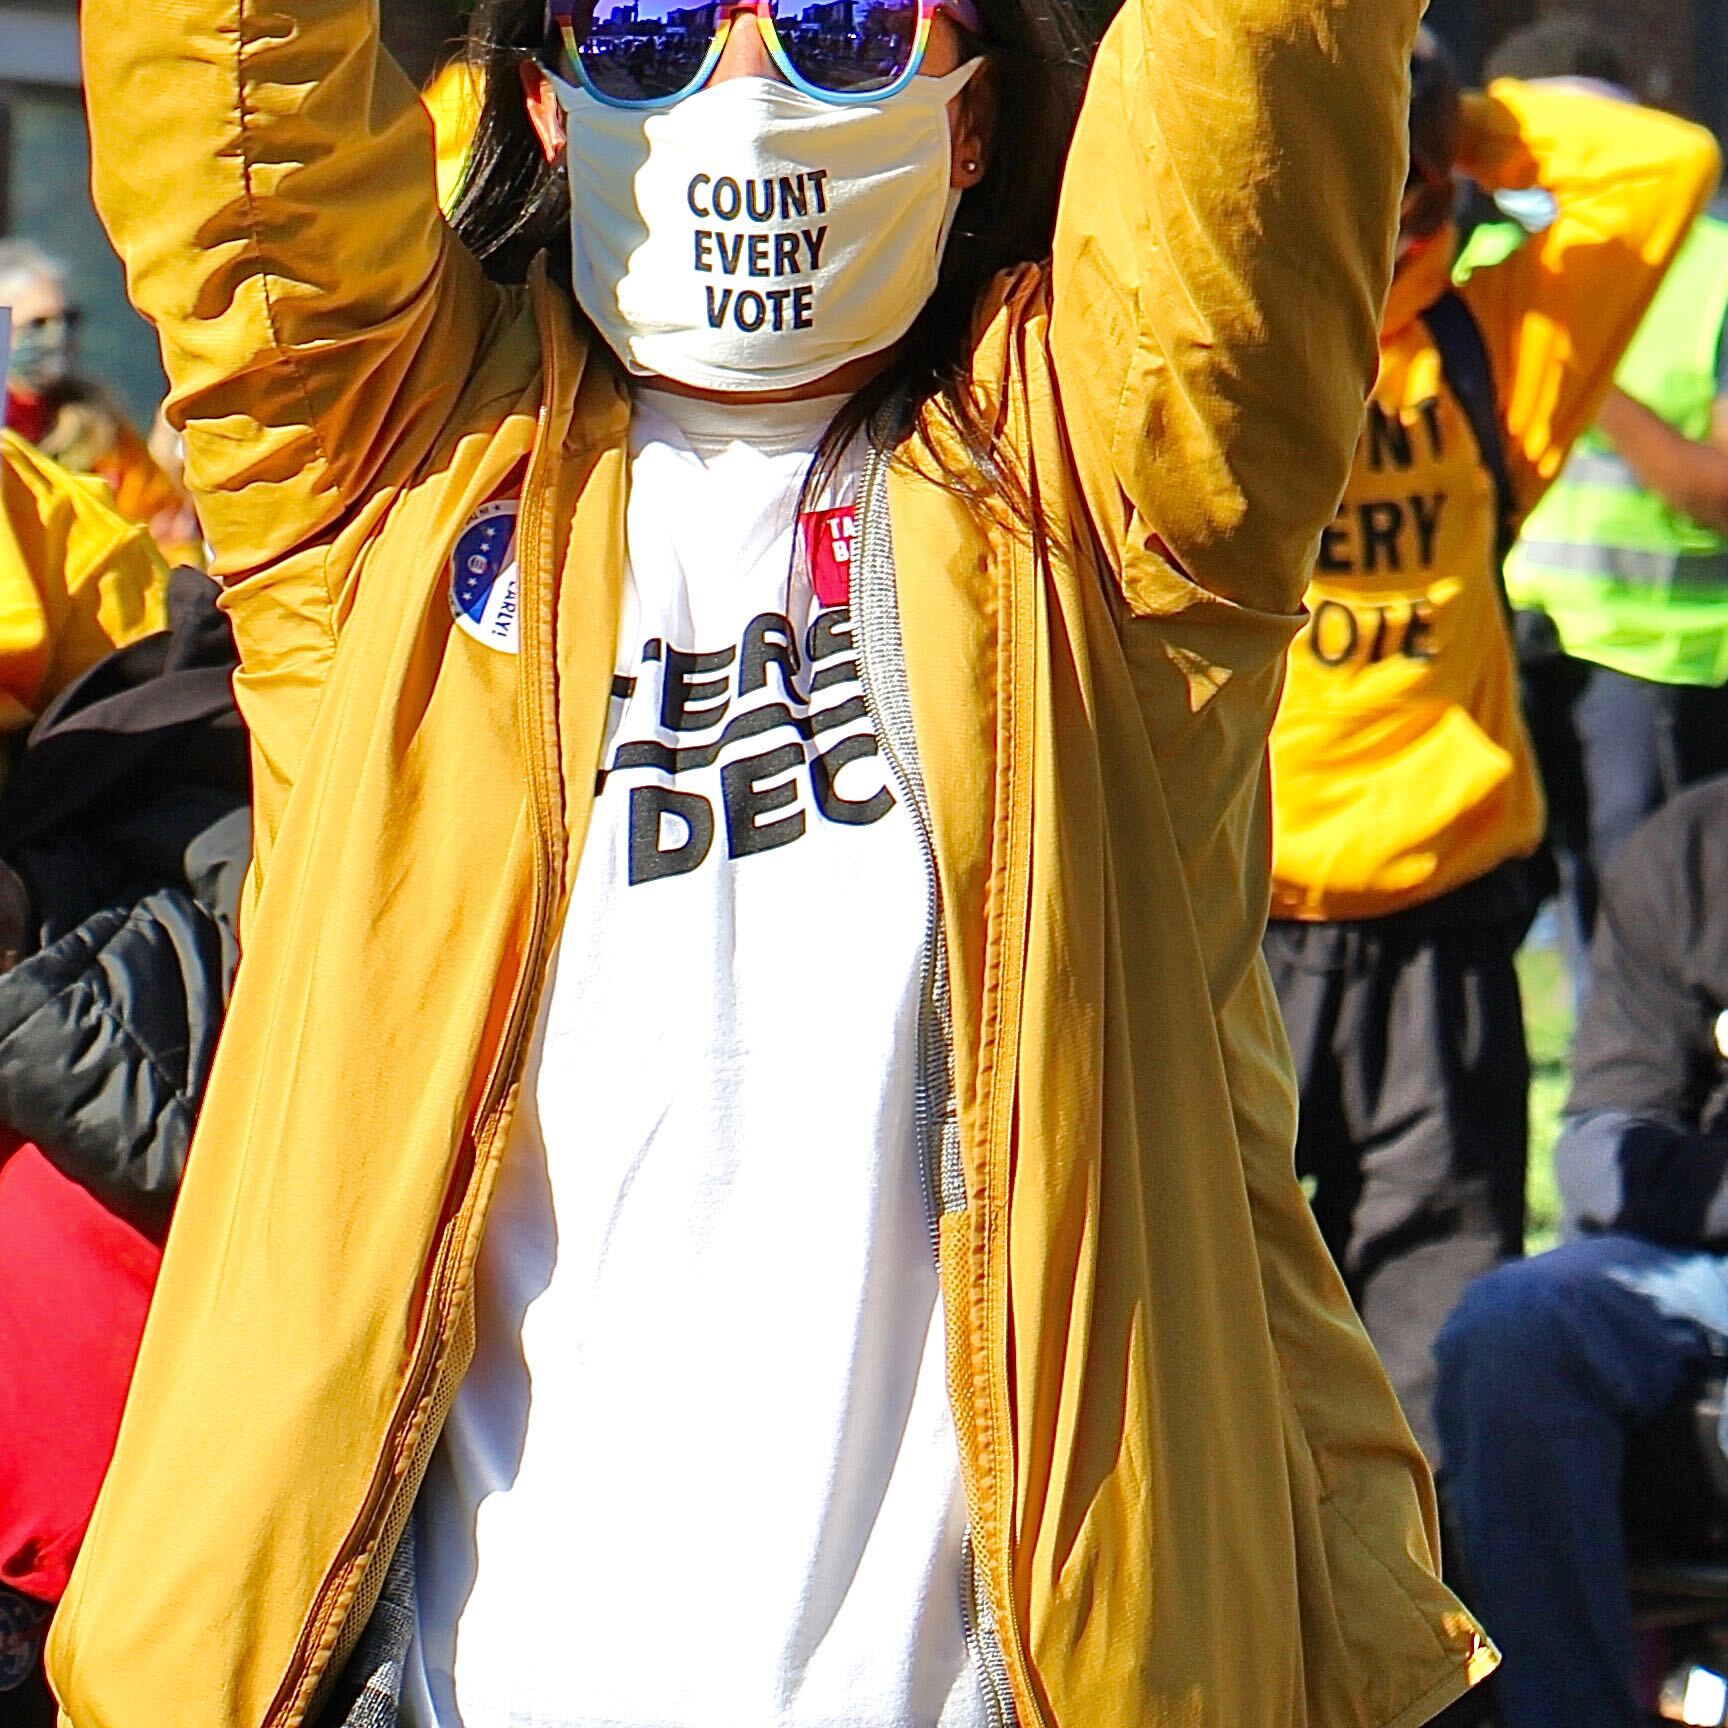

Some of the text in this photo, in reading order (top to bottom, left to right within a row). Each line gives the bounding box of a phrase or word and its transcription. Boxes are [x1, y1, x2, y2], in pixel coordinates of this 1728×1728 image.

[687, 169, 828, 222] COUNT
[694, 225, 828, 277] EVERY
[705, 284, 814, 333] VOTE
